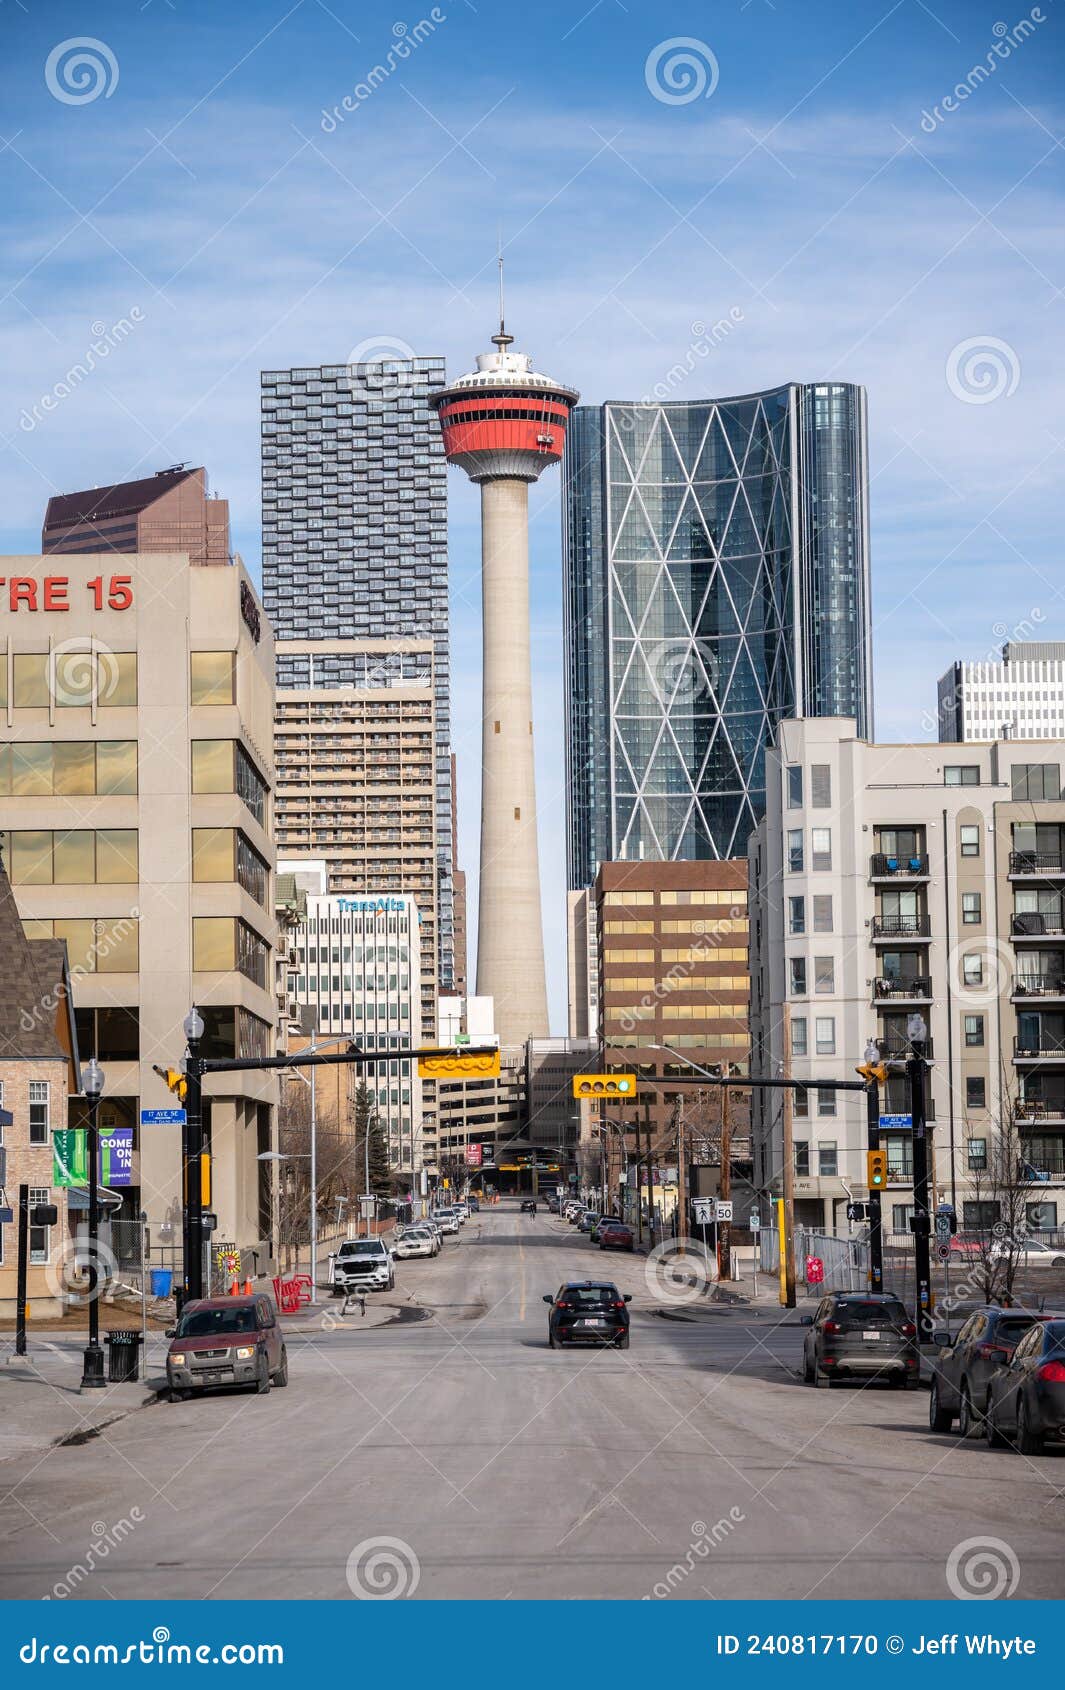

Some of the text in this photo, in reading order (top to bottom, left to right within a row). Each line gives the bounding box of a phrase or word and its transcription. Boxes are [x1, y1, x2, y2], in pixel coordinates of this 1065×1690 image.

[0, 576, 133, 611] RE 15
[336, 897, 405, 914] TransAlta
[101, 1138, 132, 1148] COME
[116, 1148, 132, 1158] ON
[120, 1158, 132, 1168] IN
[718, 1208, 732, 1218] 50
